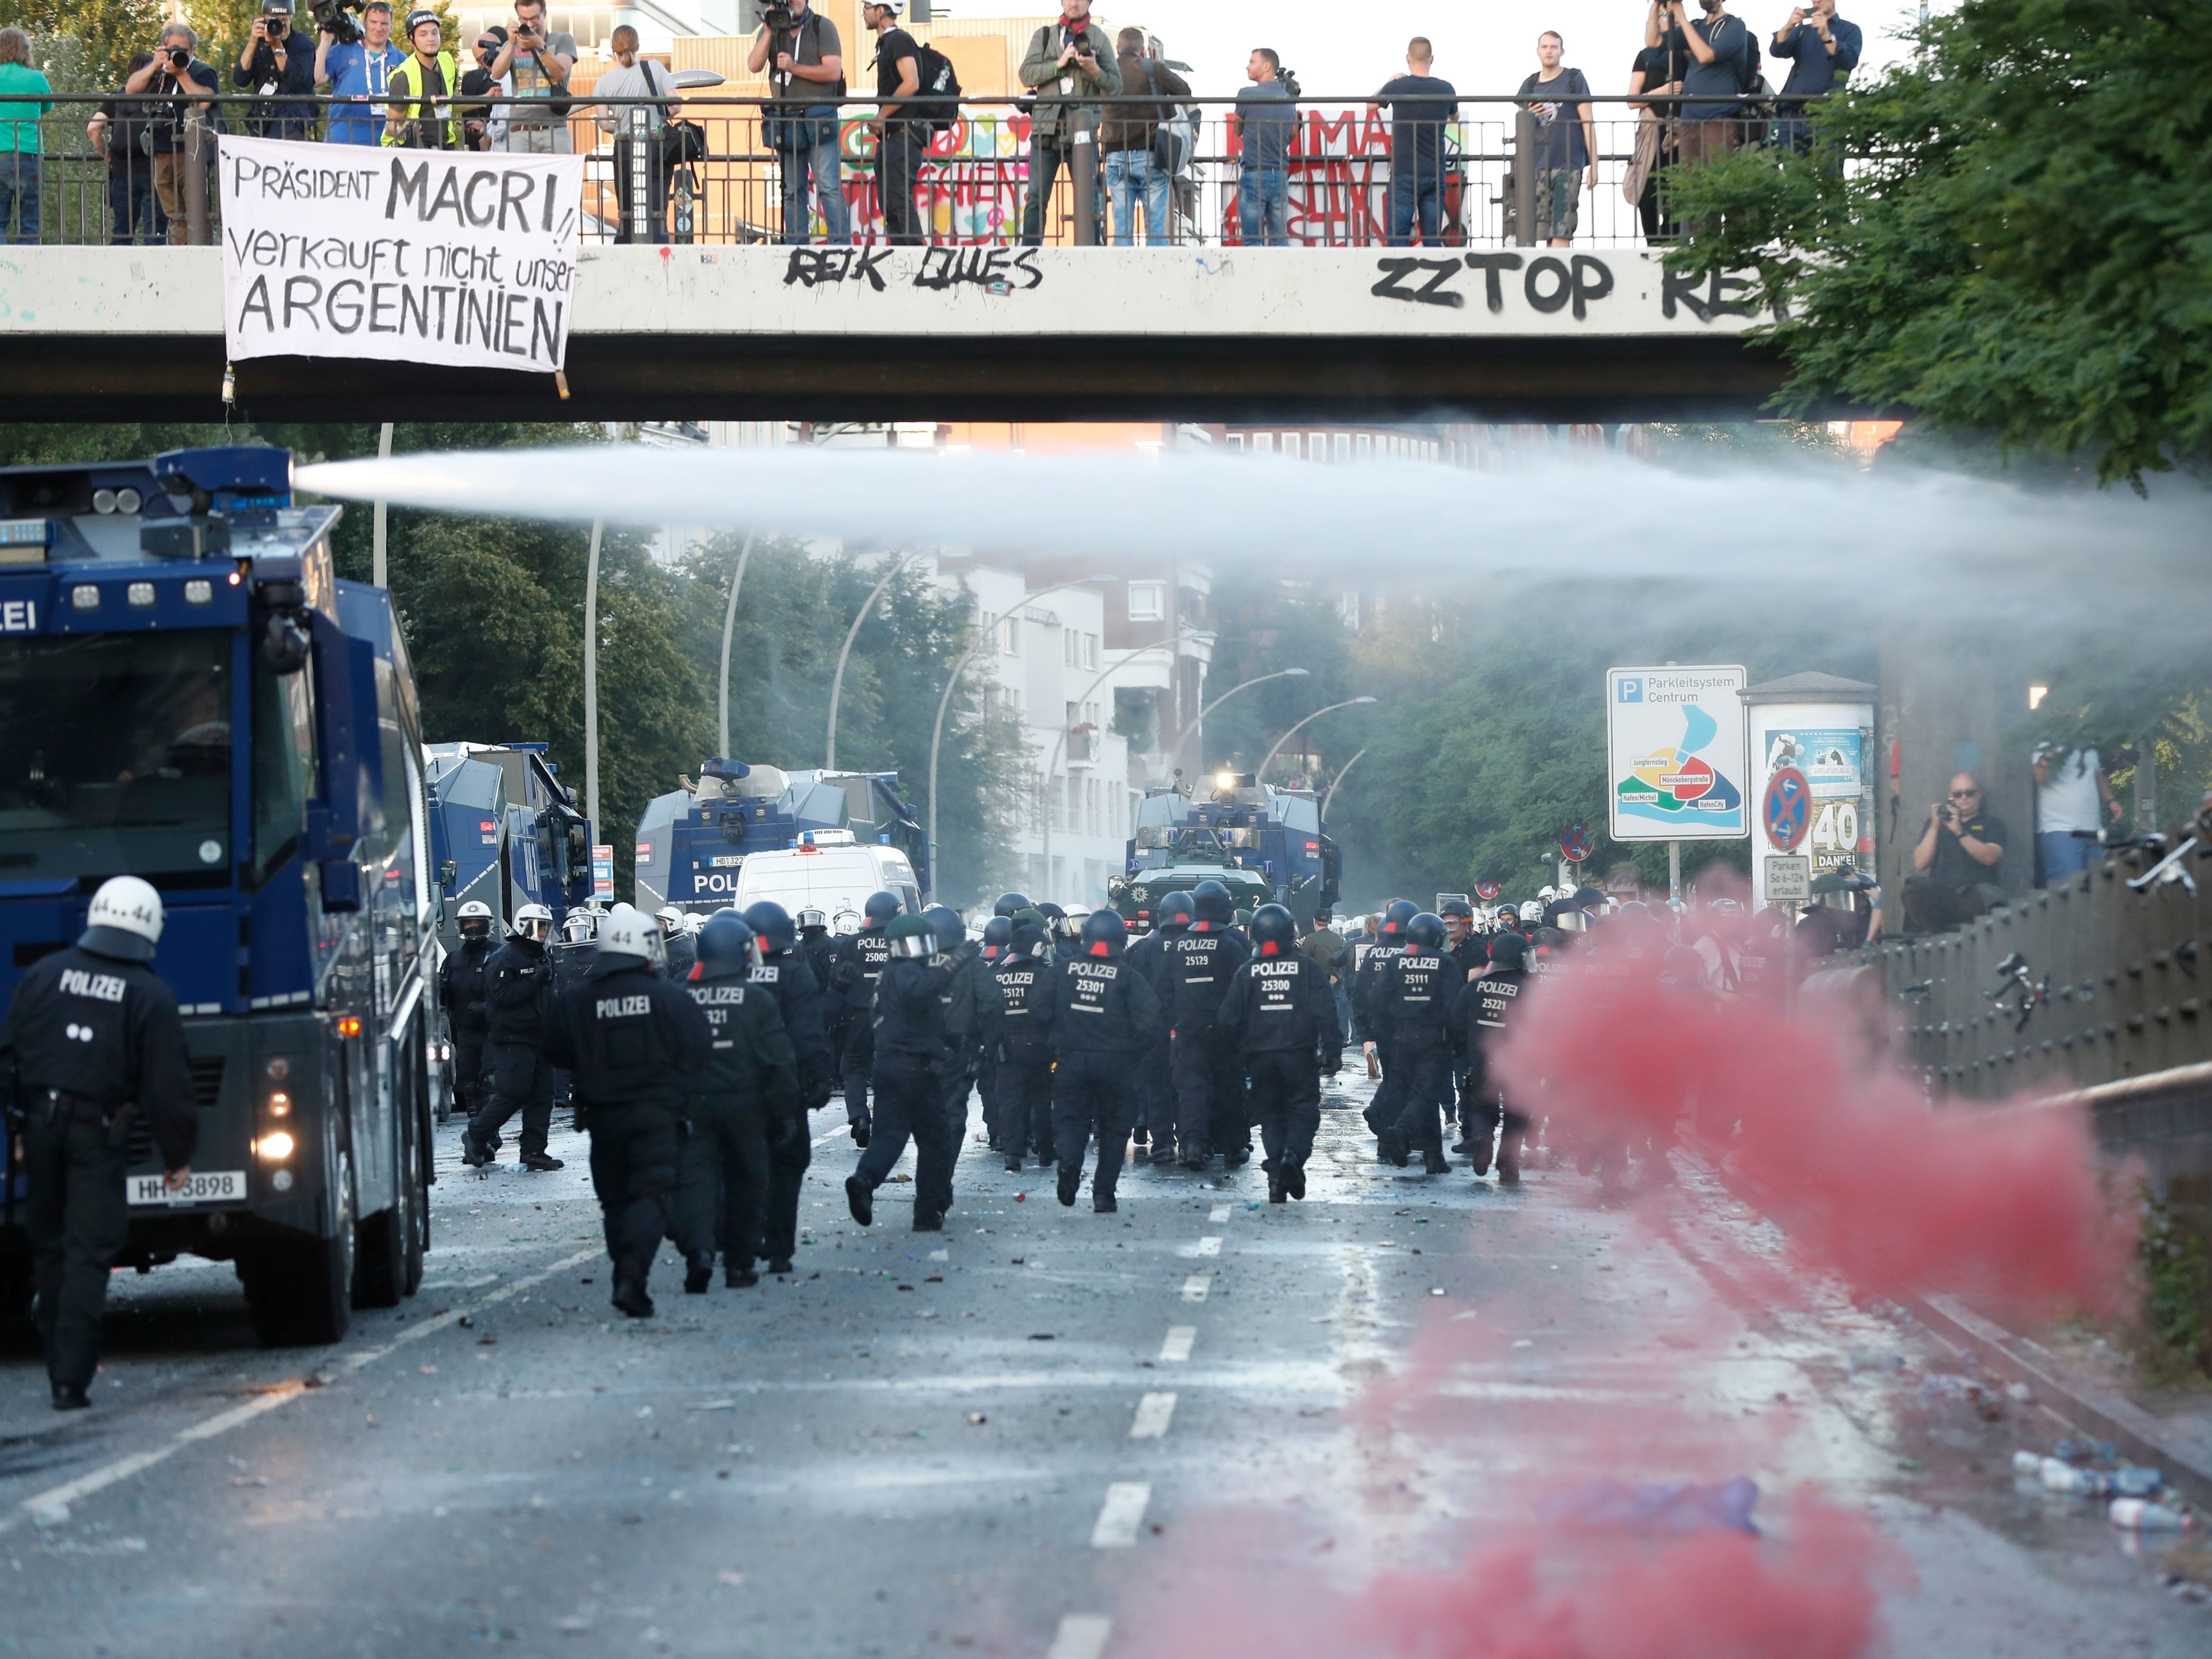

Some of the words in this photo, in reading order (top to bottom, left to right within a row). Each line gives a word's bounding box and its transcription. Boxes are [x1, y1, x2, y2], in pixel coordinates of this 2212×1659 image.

[235, 156, 380, 200] PRÄSIDENT
[424, 242, 503, 282] nicht
[1649, 677, 1735, 690] Parkleitsystem
[1649, 692, 1698, 703] Centrum
[1662, 776, 1709, 784] Mönckebergstraße
[1814, 803, 1858, 850] 40
[1772, 861, 1801, 871] Parken
[1771, 874, 1781, 883] So
[1252, 895, 1260, 908] 2
[611, 931, 631, 944] 44
[1178, 939, 1218, 951] POLIZEI
[1185, 956, 1208, 966] 25129
[1398, 957, 1440, 969] POLIZEI
[1068, 962, 1118, 979] POLIZEI
[1251, 962, 1298, 977] POLIZEI
[59, 968, 126, 1002] POLIZEI
[1261, 980, 1290, 991] 25300
[1405, 974, 1428, 984] 25111
[1076, 979, 1105, 994] 25301
[1477, 981, 1518, 997] POLIZEI
[596, 995, 651, 1019] POLIZEI
[1482, 998, 1506, 1010] 25221
[139, 1179, 166, 1199] HH
